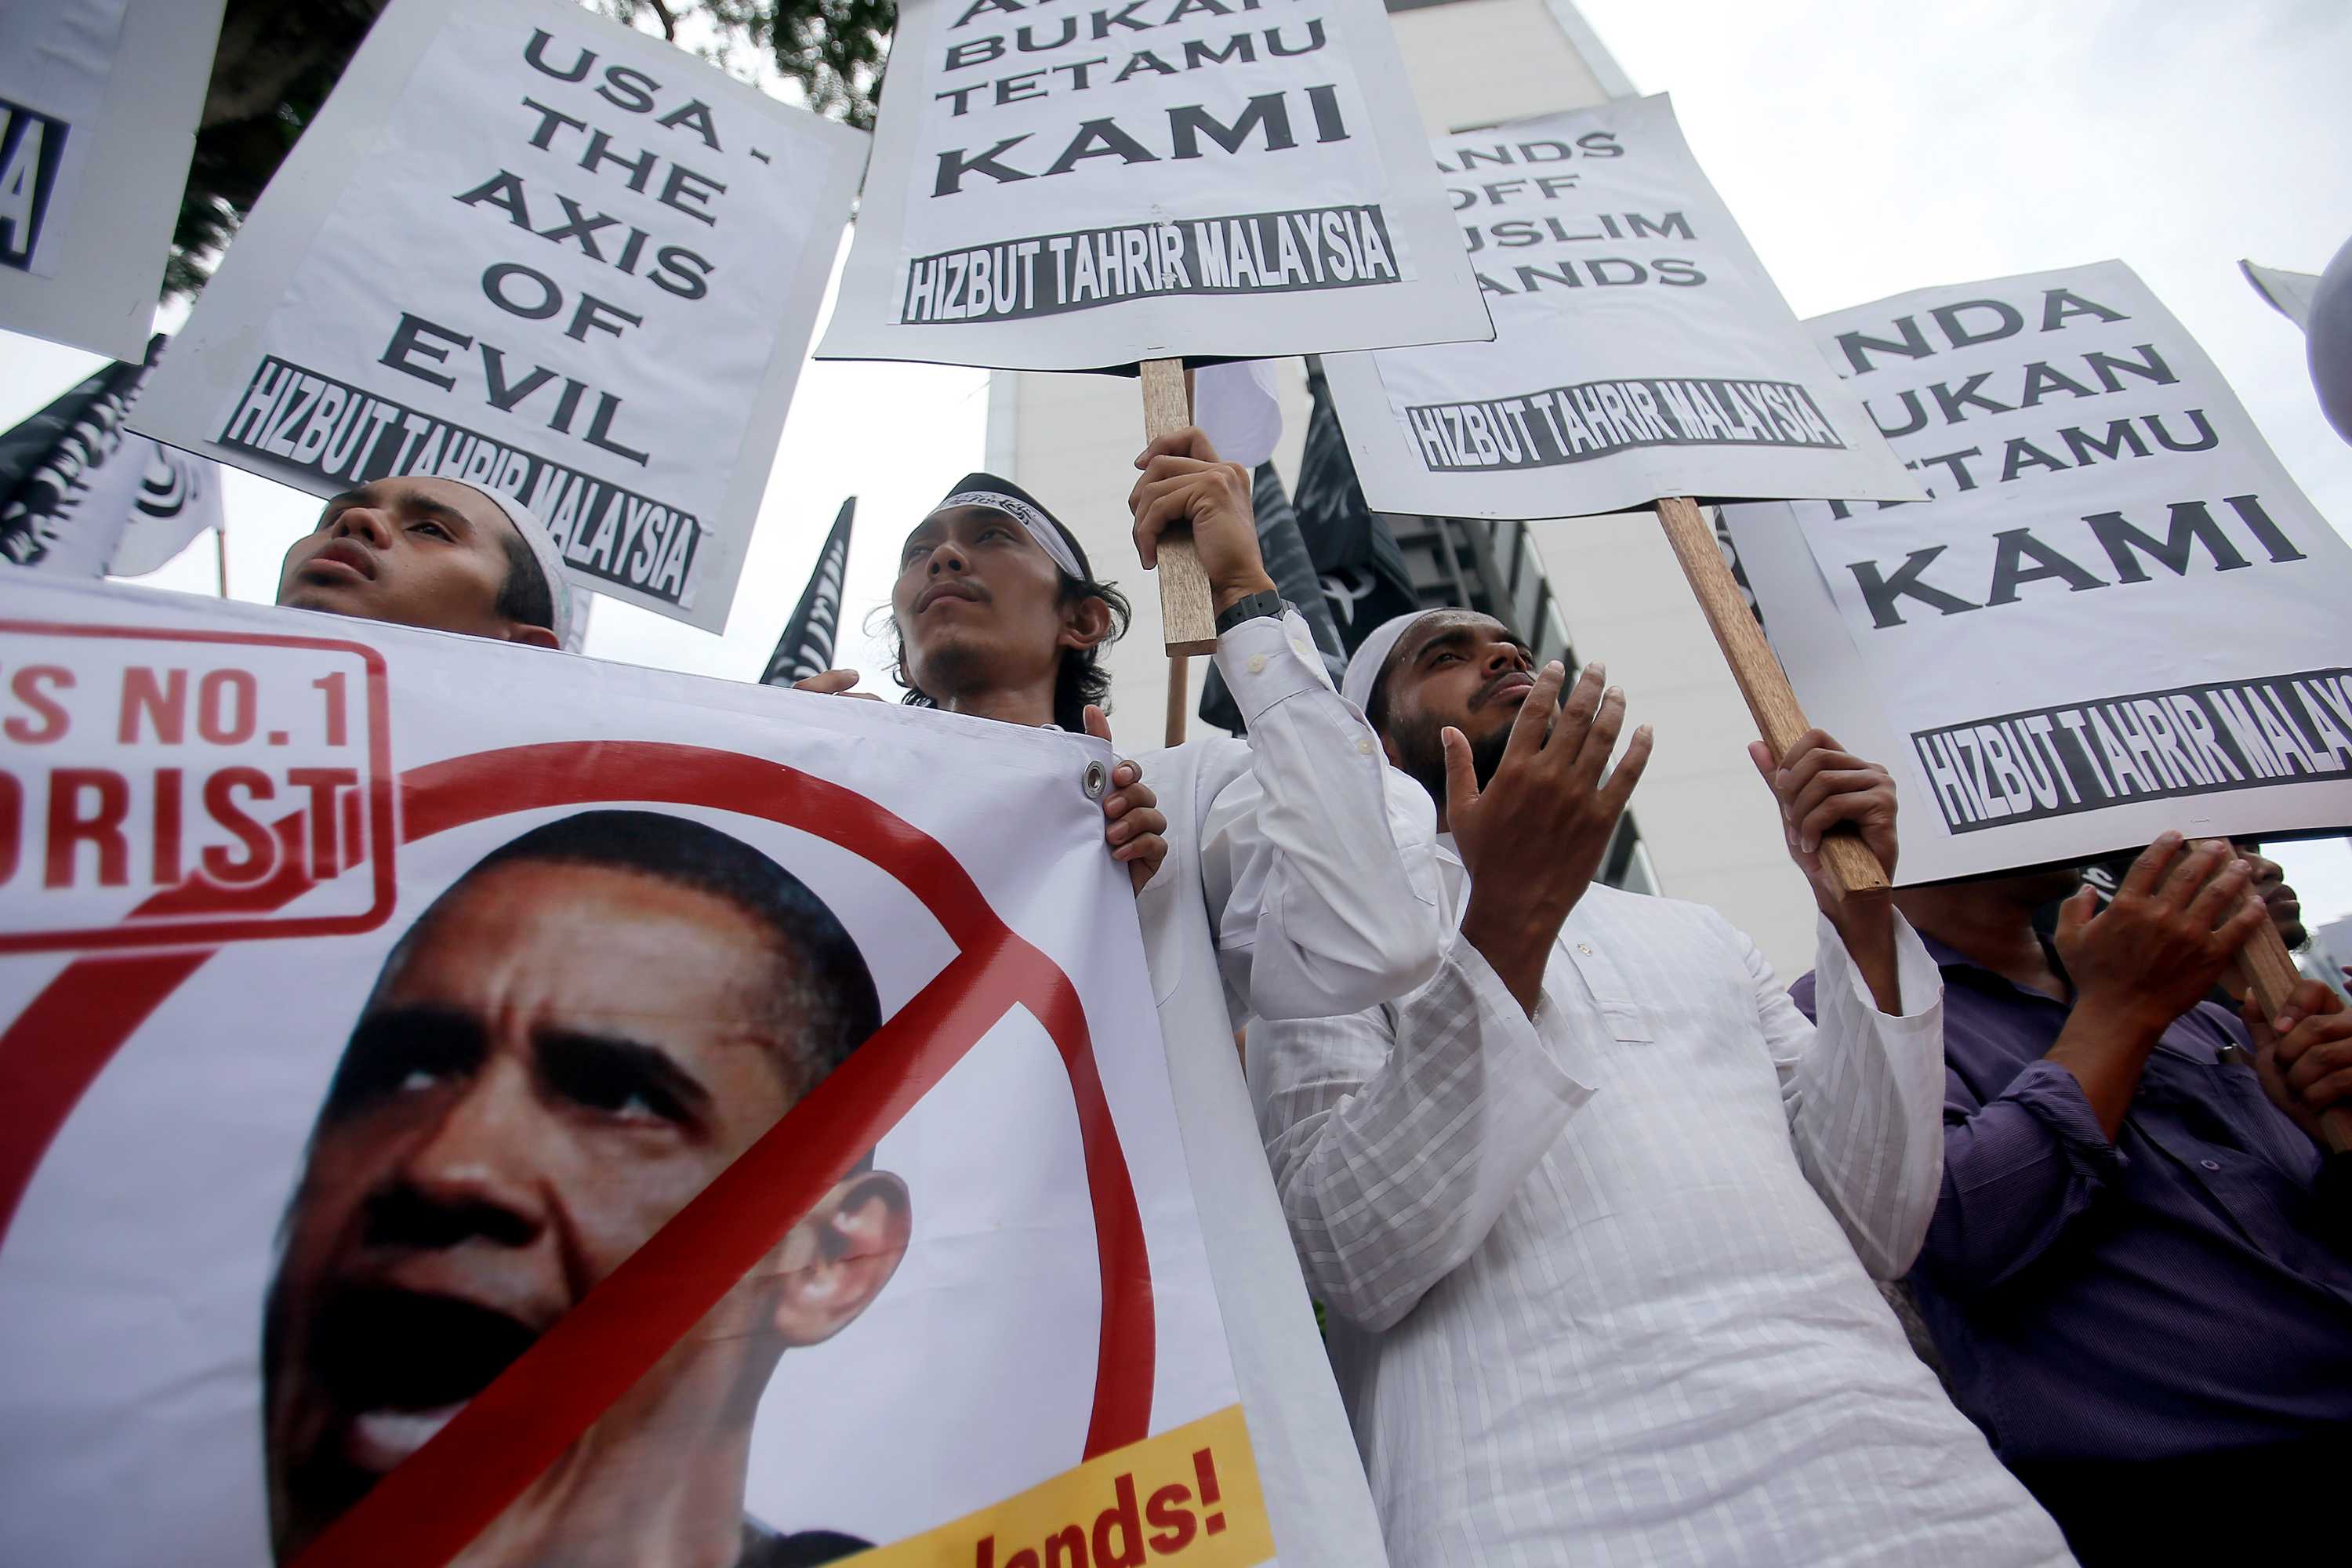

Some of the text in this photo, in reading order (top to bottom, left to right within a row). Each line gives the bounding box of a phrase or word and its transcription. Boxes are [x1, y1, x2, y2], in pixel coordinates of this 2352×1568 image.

[521, 27, 724, 152] USA
[935, 18, 1327, 116] TETAMU
[943, 0, 1301, 71] BUKA
[521, 96, 728, 227] THE
[931, 84, 1350, 198] KAMI
[1436, 132, 1624, 172] NDS
[452, 169, 717, 300] AXIS
[906, 209, 1395, 321] HIZBUT TAHRIR MALAYSIA
[1463, 212, 1697, 252] SLIM
[1476, 257, 1708, 295] ANDS
[482, 263, 644, 343] OF
[1835, 288, 2131, 379] NDA
[378, 311, 650, 467] EVIL
[1410, 398, 1541, 468] HIZBUT
[1534, 380, 1677, 456] TAHRIR
[1657, 379, 1842, 447] MALAYSIA
[1861, 343, 2180, 438] UKAN
[228, 361, 400, 482] HIZBUT
[527, 463, 696, 597] MALAYSIA
[1828, 408, 2220, 521] TAMU
[1846, 494, 2307, 629] KAMI
[1917, 713, 2082, 826] HIZBUT
[2056, 693, 2246, 799] TAHRIR
[976, 1446, 1227, 1568] nds!
